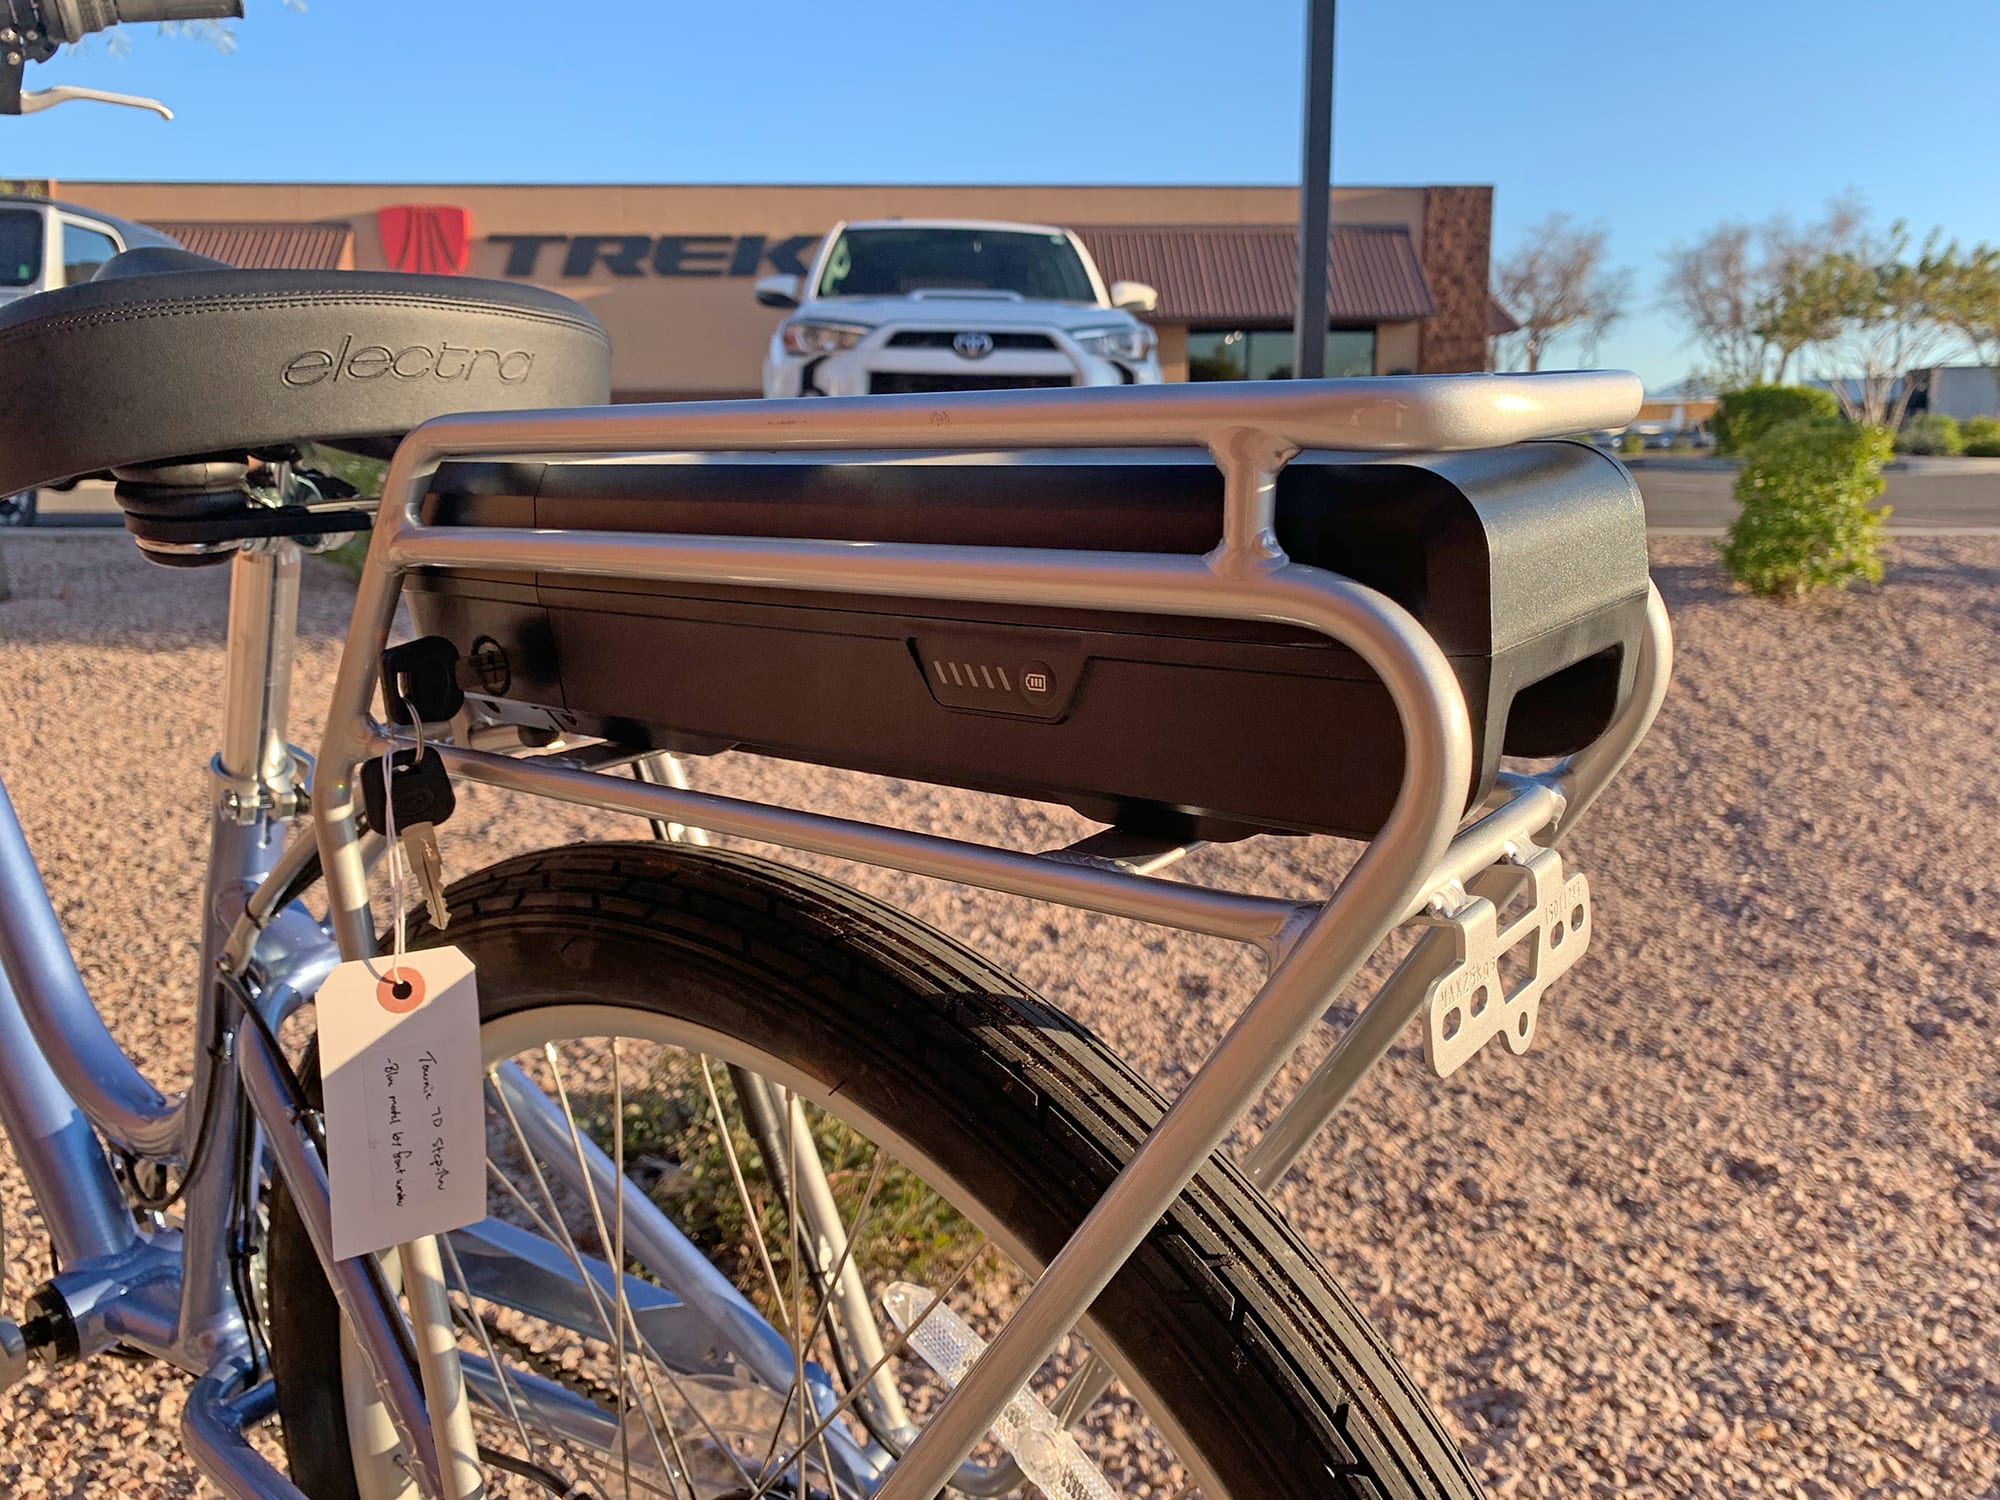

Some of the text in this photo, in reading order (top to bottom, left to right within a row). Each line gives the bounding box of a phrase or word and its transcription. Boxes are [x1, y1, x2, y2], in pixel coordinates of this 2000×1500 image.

[487, 234, 823, 277] TREK
[281, 334, 535, 390] electra
[418, 1050, 438, 1100] Townie
[431, 1106, 443, 1128] 7D
[393, 1150, 413, 1175] front
